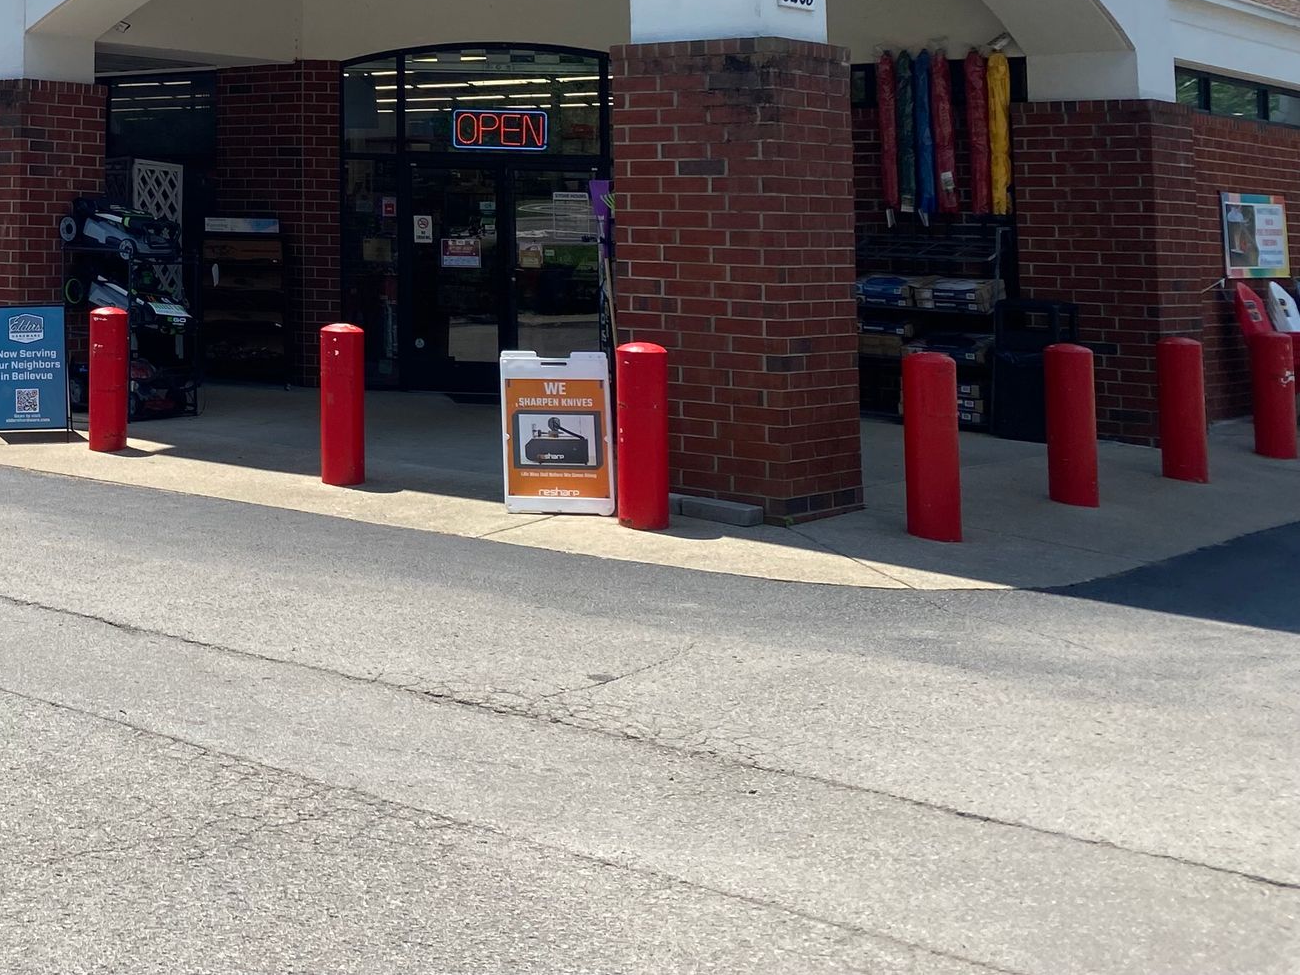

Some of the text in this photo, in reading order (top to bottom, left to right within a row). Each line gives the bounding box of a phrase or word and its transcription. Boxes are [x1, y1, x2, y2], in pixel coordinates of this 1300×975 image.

[456, 112, 544, 147] OPEN
[19, 348, 56, 359] Serving
[11, 360, 60, 371] Neighbors
[0, 371, 53, 380] in Bellevue
[544, 382, 566, 395] WE
[518, 397, 593, 407] SHARPEN KNIVES
[538, 486, 580, 497] resharp
